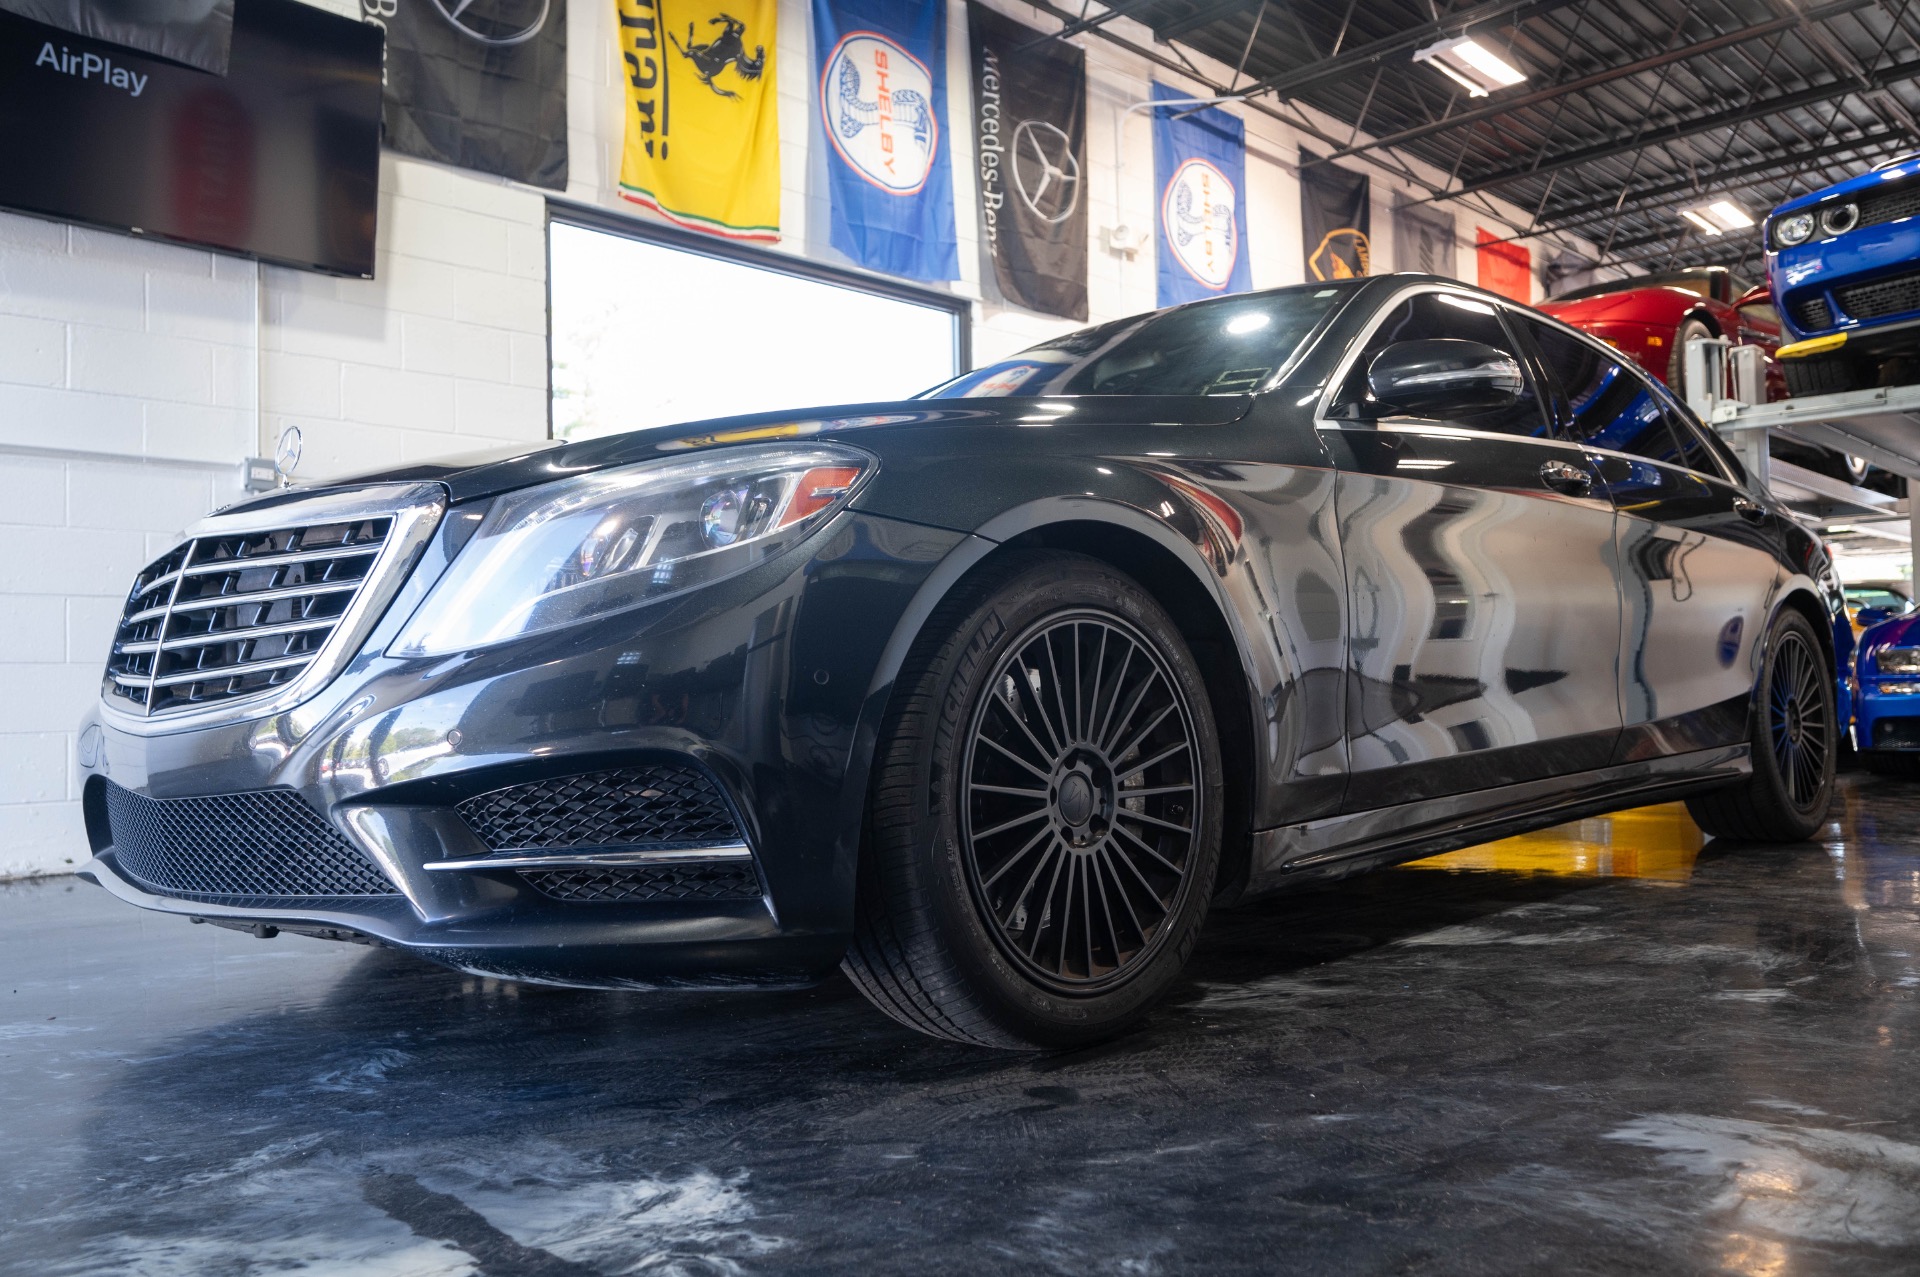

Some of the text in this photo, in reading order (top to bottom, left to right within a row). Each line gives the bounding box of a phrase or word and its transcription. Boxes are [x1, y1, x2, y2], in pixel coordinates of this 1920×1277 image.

[35, 42, 148, 97] AirPlay
[874, 48, 896, 175] SHELBY
[1201, 172, 1215, 273] SHELBY
[933, 612, 1001, 770] MICHELIN
